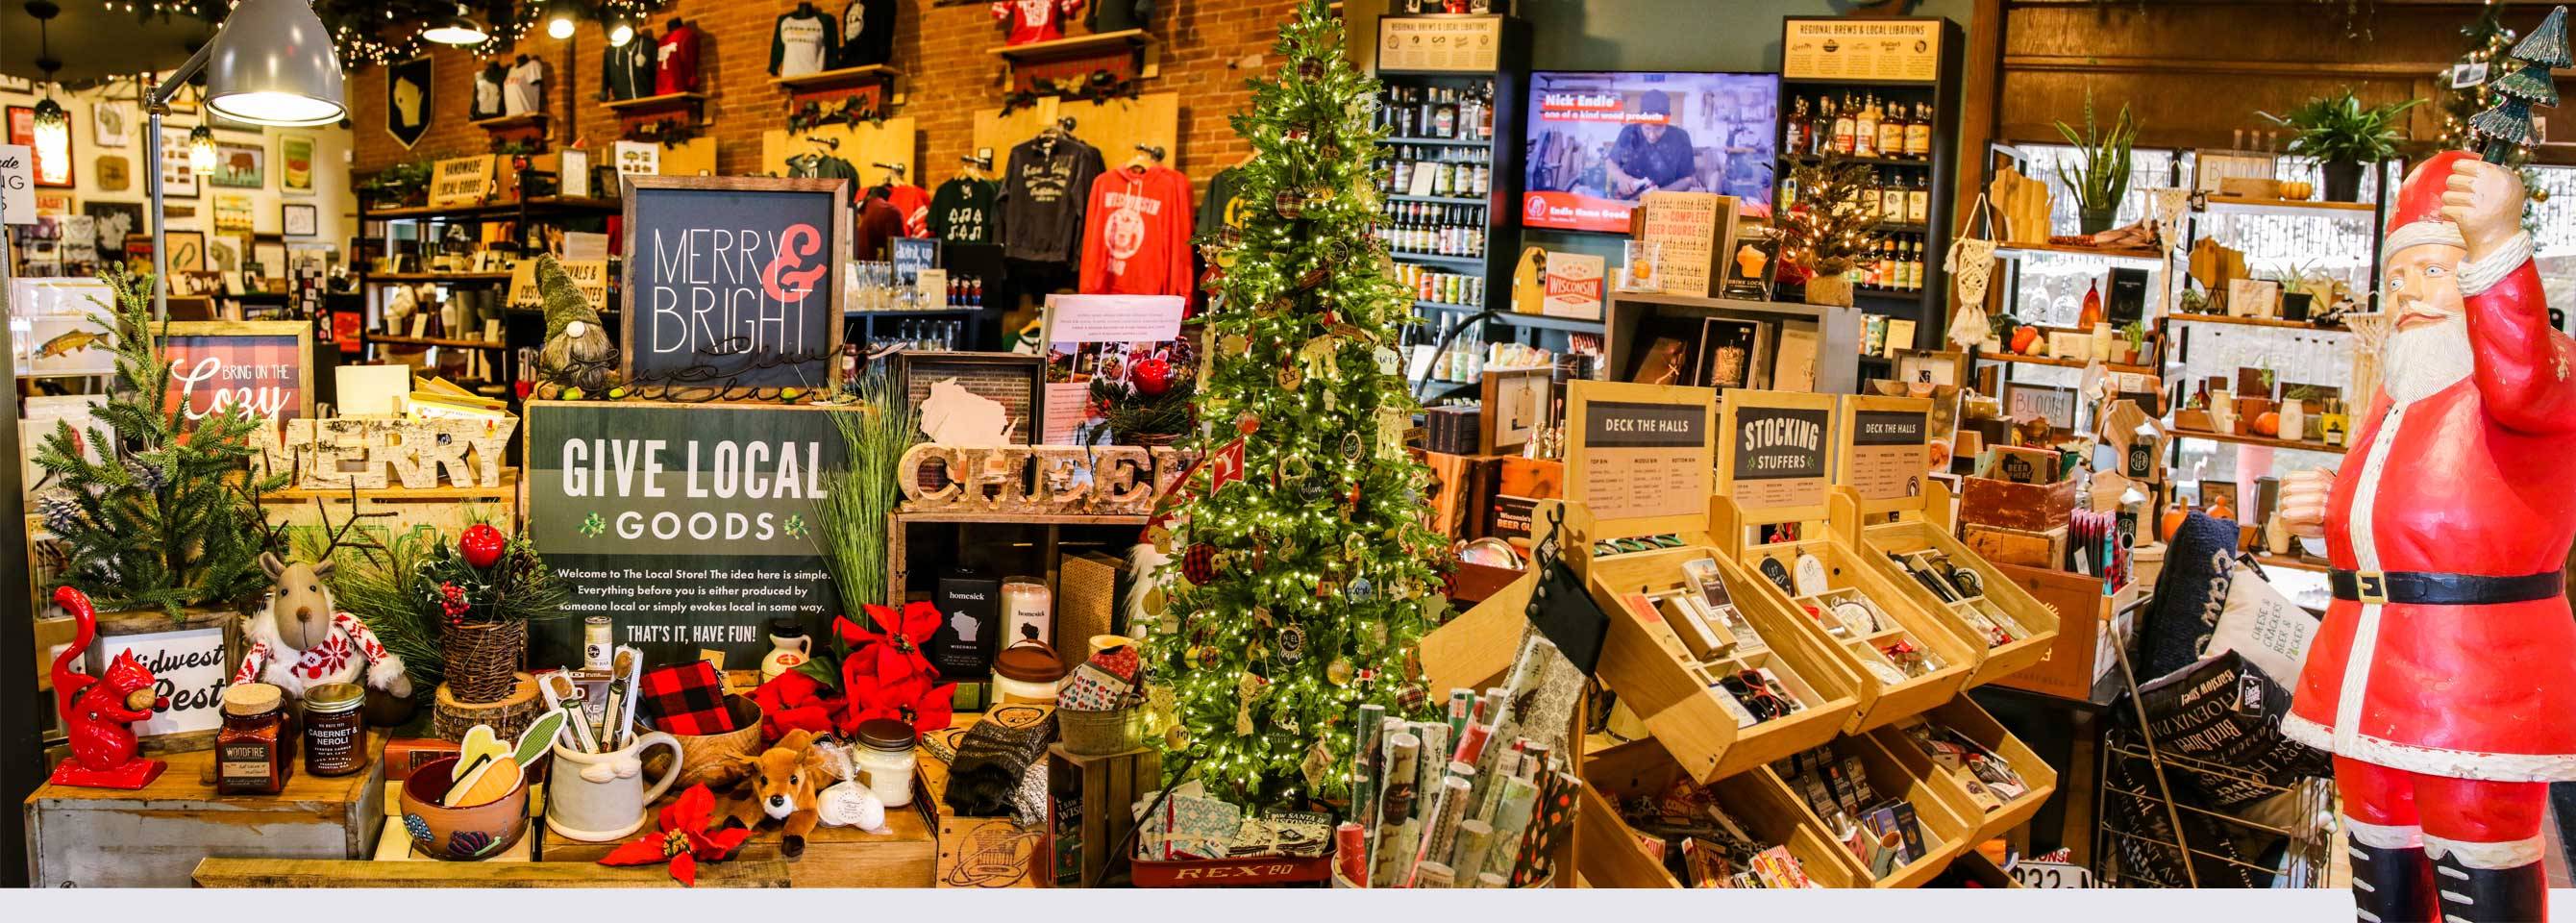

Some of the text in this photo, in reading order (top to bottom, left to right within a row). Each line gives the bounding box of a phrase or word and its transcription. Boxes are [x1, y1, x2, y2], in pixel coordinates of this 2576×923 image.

[1799, 24, 1832, 35] REGIONAL
[1834, 24, 1857, 35] BREWS
[1867, 24, 1888, 35] LOCAL
[1889, 24, 1925, 36] LIBATIONS
[1545, 94, 1575, 106] Nick
[1601, 112, 1625, 120] wood
[1625, 112, 1664, 122] products
[445, 159, 482, 175] HANDMADE
[438, 179, 483, 196] LOCAL GOODS
[1574, 208, 1600, 217] Home
[1601, 209, 1630, 219] Goods
[1671, 211, 1710, 223] COMPLETE
[1647, 225, 1697, 237] BEER COURSE
[654, 228, 786, 285] MERRY
[762, 223, 827, 303] &
[1549, 277, 1598, 296] WISCONSIN
[654, 287, 813, 355] BRIGHT
[223, 364, 289, 380] BRING ON THE
[171, 357, 291, 421] Cozy
[1605, 419, 1690, 433] DECK THE HALLS
[1866, 423, 1917, 434] DECK THE HALLS
[1745, 417, 1820, 451] STOCKING
[249, 418, 520, 490] MERRY
[1217, 443, 1240, 478] Y
[562, 438, 829, 499] GIVE LOCAL
[1757, 456, 1806, 469] STUFFERS
[2007, 463, 2029, 472] BEER
[1497, 519, 1519, 530] BEER
[1499, 512, 1530, 523] Wisconsin's
[615, 511, 775, 541] GOODS
[557, 569, 831, 583] Welcome to The Local Store! The idea here is simple.
[577, 585, 808, 599] Everything before you is either produced by
[609, 602, 636, 611] local
[653, 602, 686, 613] simply
[690, 602, 727, 611] evokes
[729, 602, 755, 612] local
[756, 602, 767, 612] in
[769, 604, 796, 612] some
[800, 604, 826, 614] way.
[2252, 606, 2268, 641] CHEESE
[2263, 602, 2282, 648] CRACKERS
[627, 625, 755, 645] THAT'S IT, HAVE FUN!
[2274, 629, 2288, 654] BEER
[2286, 622, 2305, 661] PACKERS
[135, 644, 225, 675] idwest
[308, 728, 352, 738] CABERNET
[2206, 718, 2242, 748] Birch
[317, 736, 349, 746] NEROLI
[226, 747, 264, 758] WOODFIRE
[1063, 800, 1077, 810] SAW
[1175, 864, 1294, 879] REX '80
